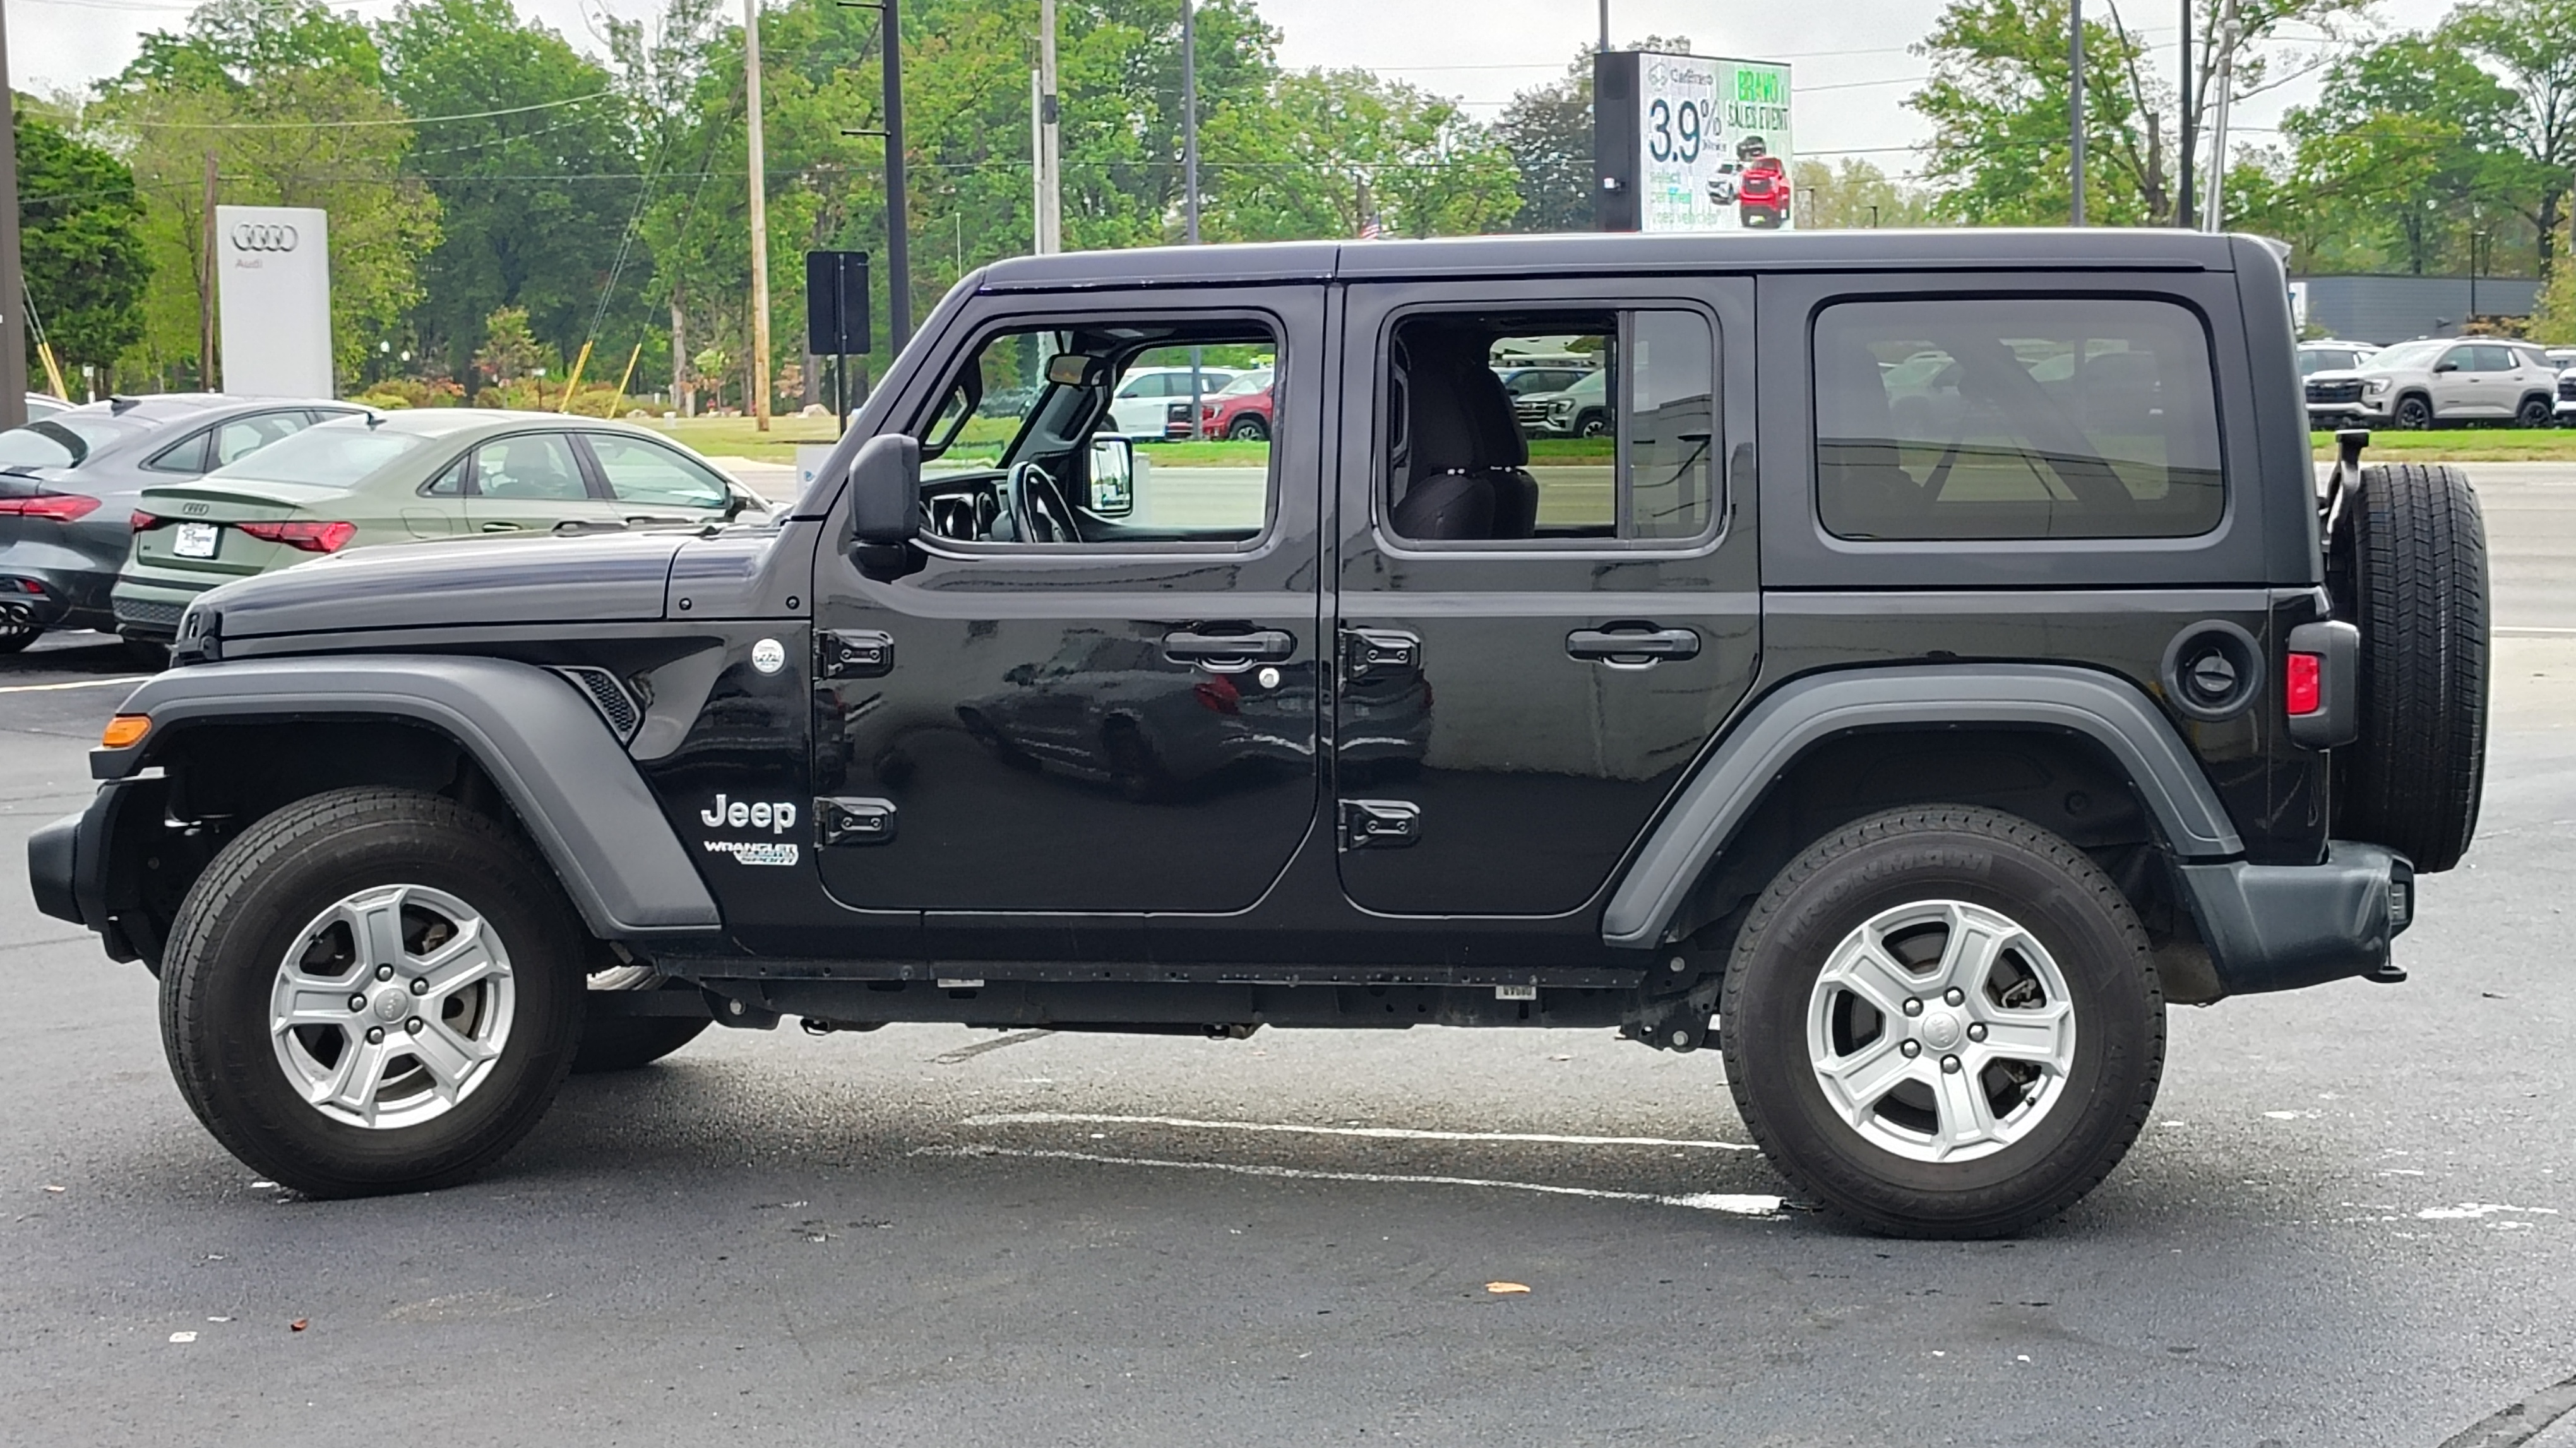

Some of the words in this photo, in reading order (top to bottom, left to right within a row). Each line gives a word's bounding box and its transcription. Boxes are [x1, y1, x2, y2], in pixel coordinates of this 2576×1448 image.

[1728, 102, 1756, 128] SALES
[1760, 106, 1788, 130] EVENT
[1650, 99, 1722, 163] 3.9%
[236, 259, 263, 269] Audi
[701, 793, 796, 834] Jeep
[703, 841, 798, 852] WRANGLER
